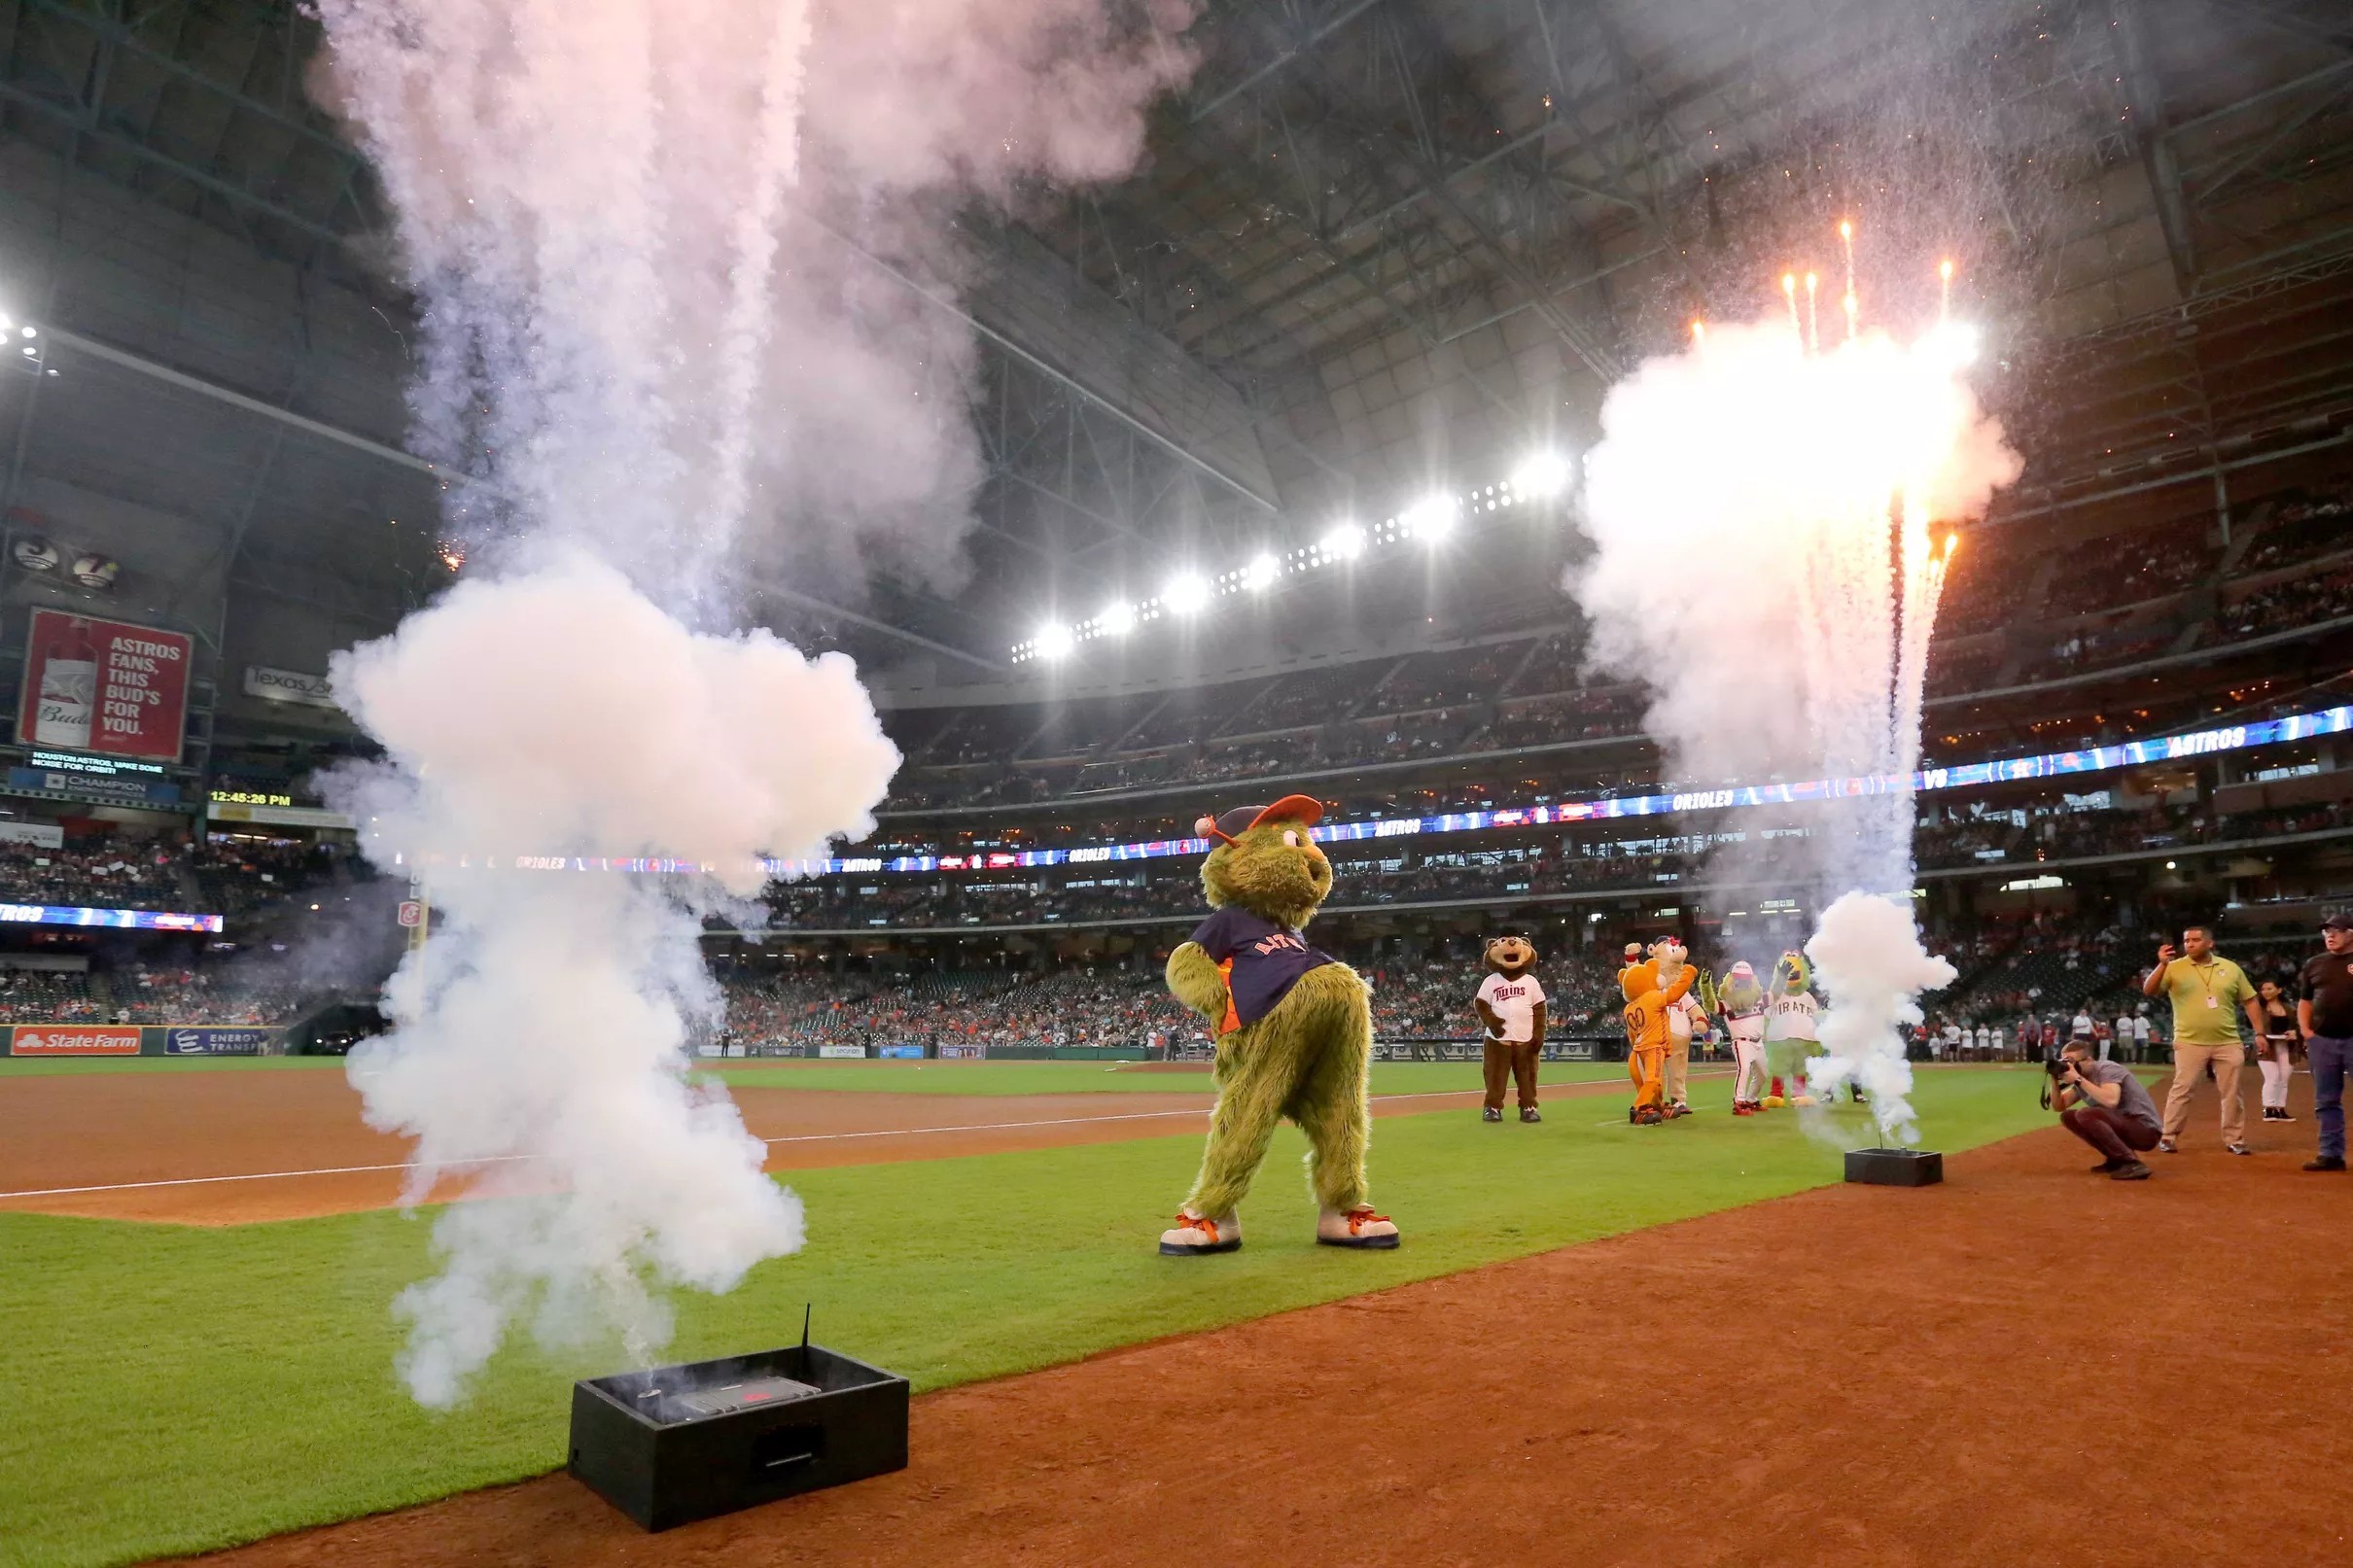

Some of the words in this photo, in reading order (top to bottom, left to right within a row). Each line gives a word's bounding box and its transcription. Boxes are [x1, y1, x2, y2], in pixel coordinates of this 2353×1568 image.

[111, 637, 181, 661] ASTROS
[110, 652, 159, 676] FANS,
[108, 668, 149, 687] THIS
[106, 684, 160, 706] BUD'S
[104, 701, 140, 718] FOR
[102, 716, 144, 736] YOU.
[2167, 726, 2245, 757] ASTROS
[32, 758, 63, 769] NOISE
[63, 762, 85, 771] FOR
[33, 751, 77, 762] HOUSTON
[114, 761, 138, 771] MAKE
[138, 764, 163, 774] SOME
[68, 776, 146, 792] CHAMPION
[210, 790, 266, 805] 12:45:26
[269, 794, 291, 807] PM
[1672, 789, 1734, 812] ORIOLES
[1374, 819, 1422, 838] ASTROS
[1069, 846, 1111, 864] ORIOLES
[1493, 984, 1526, 1002] Twins
[1626, 1006, 1645, 1032] 00
[209, 1033, 260, 1043] ENERGY
[209, 1043, 258, 1052] TRANSF
